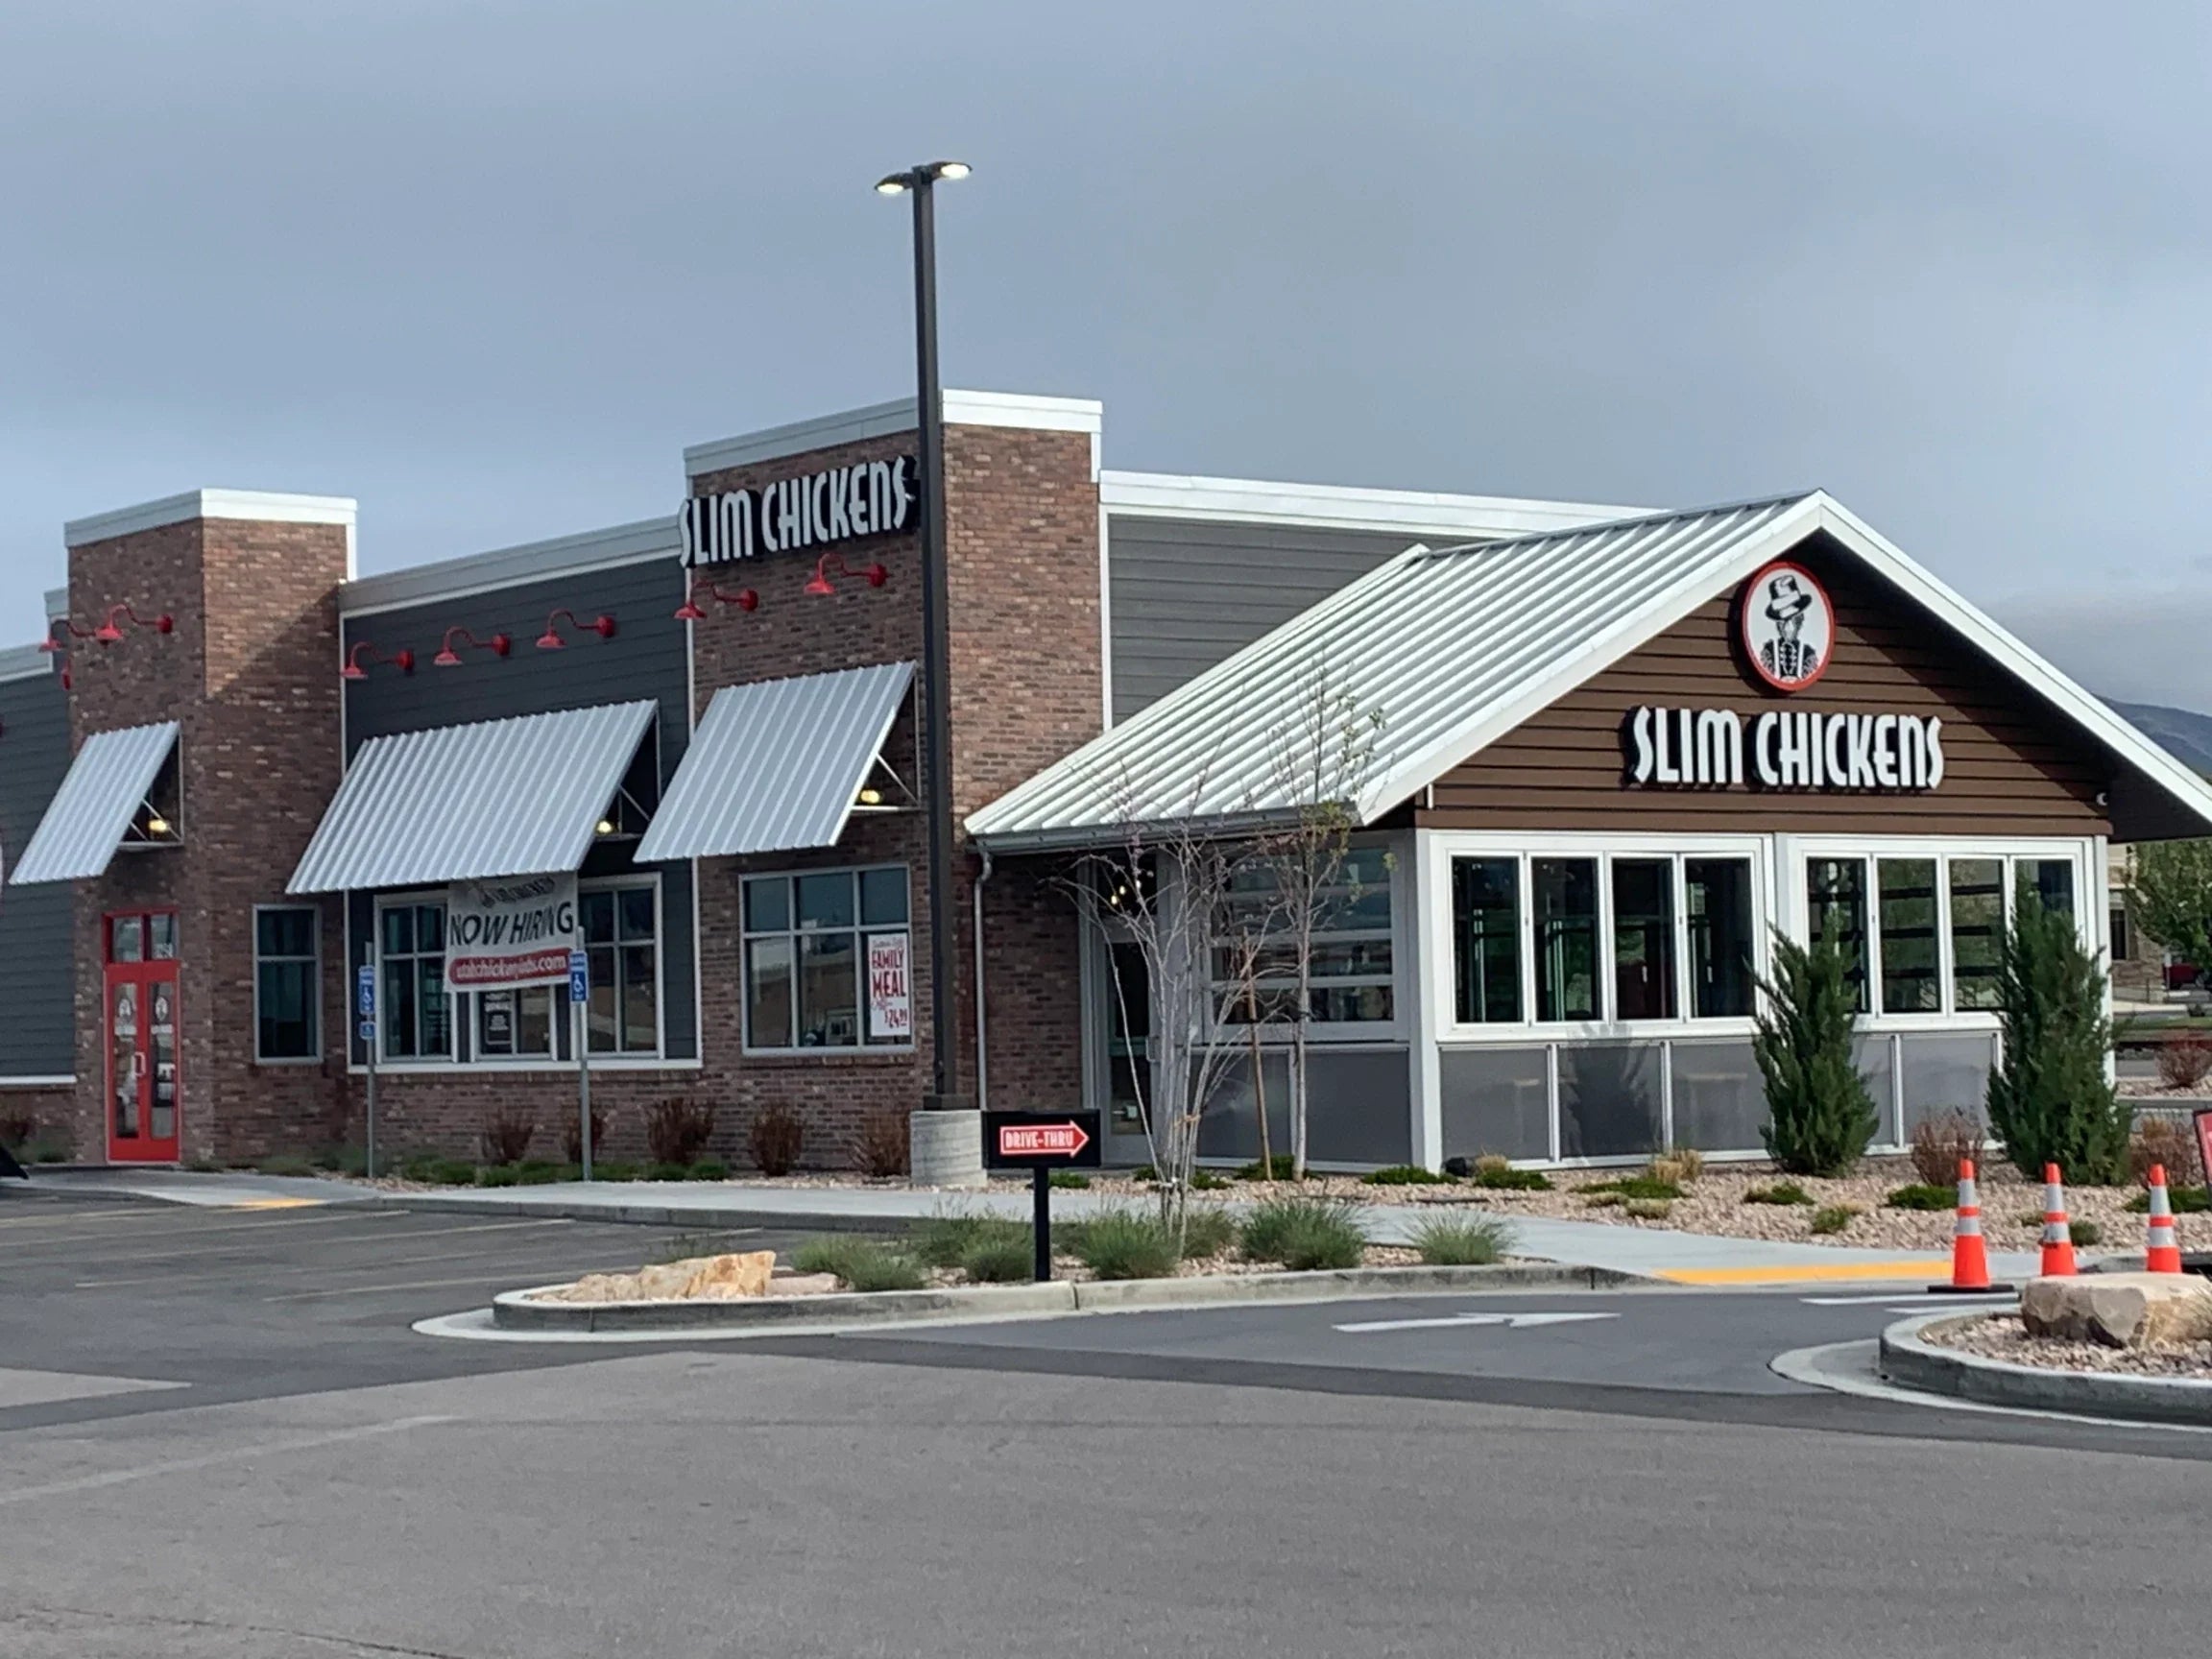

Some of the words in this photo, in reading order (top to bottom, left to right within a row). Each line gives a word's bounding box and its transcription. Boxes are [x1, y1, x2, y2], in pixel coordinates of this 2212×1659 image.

[677, 489, 754, 568] SLIM
[761, 455, 907, 552] CHICKENS
[1633, 706, 1743, 783] SLIM
[1756, 711, 1945, 789] CHICKENS
[449, 914, 509, 946] NOW
[872, 948, 904, 970] FAMILY
[872, 970, 907, 998] MEAL
[1005, 1130, 1074, 1148] DRIVE-THRU
